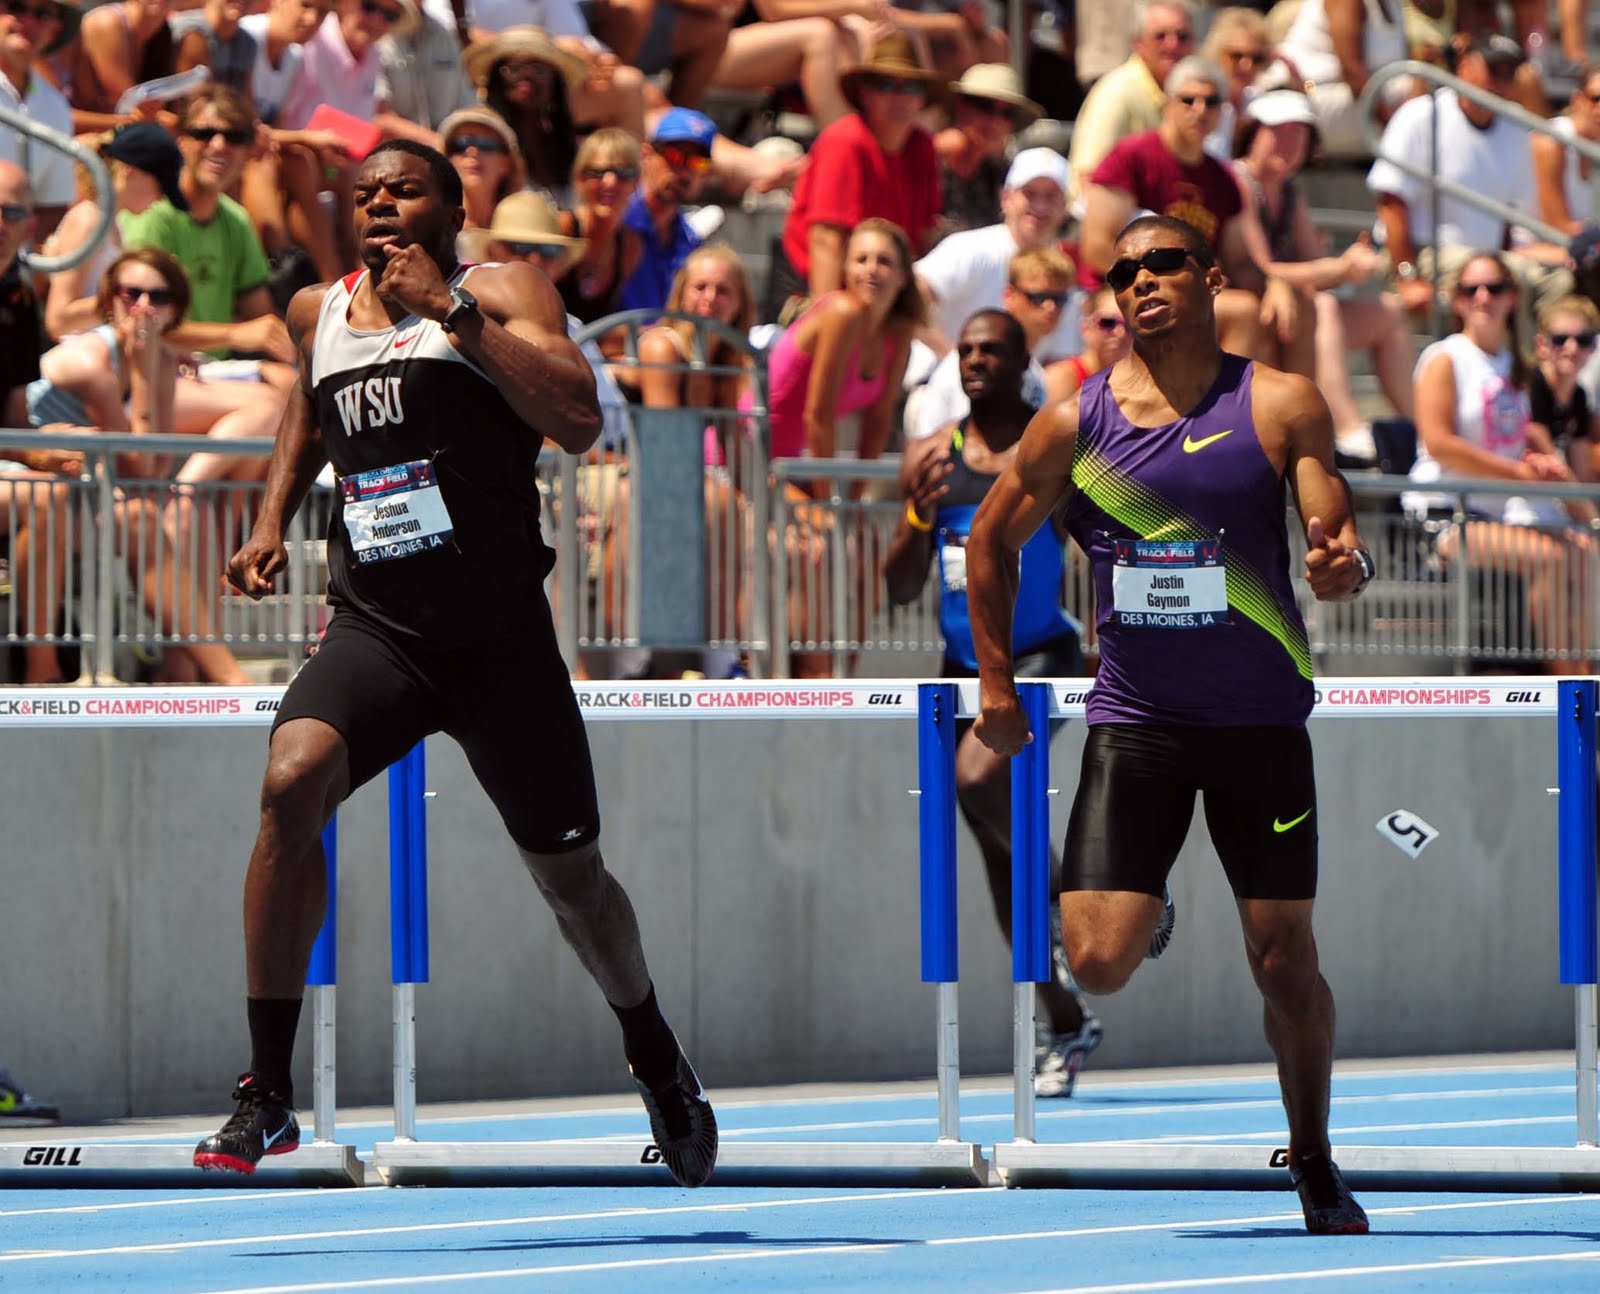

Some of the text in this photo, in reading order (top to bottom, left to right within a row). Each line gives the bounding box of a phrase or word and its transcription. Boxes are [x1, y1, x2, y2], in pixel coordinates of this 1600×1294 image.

[334, 377, 404, 437] WSU
[373, 502, 409, 520] Jeshua
[371, 518, 421, 541] Anderson
[358, 537, 443, 563] DES MOINES, IA
[1150, 575, 1184, 590] Justin
[1147, 593, 1190, 610] Gaymon
[1121, 613, 1214, 628] DES MOINES, IA
[255, 700, 281, 711] GIL
[575, 691, 854, 708] RACK&FIELD CHAMPIONSHIPS
[868, 693, 903, 705] GILL
[1328, 689, 1491, 705] CHAMPIONSHIPS
[1505, 691, 1541, 703] GILL
[86, 698, 241, 715] CHAMPIONSHIPS
[1388, 814, 1428, 849] 5
[23, 1147, 82, 1166] GILL
